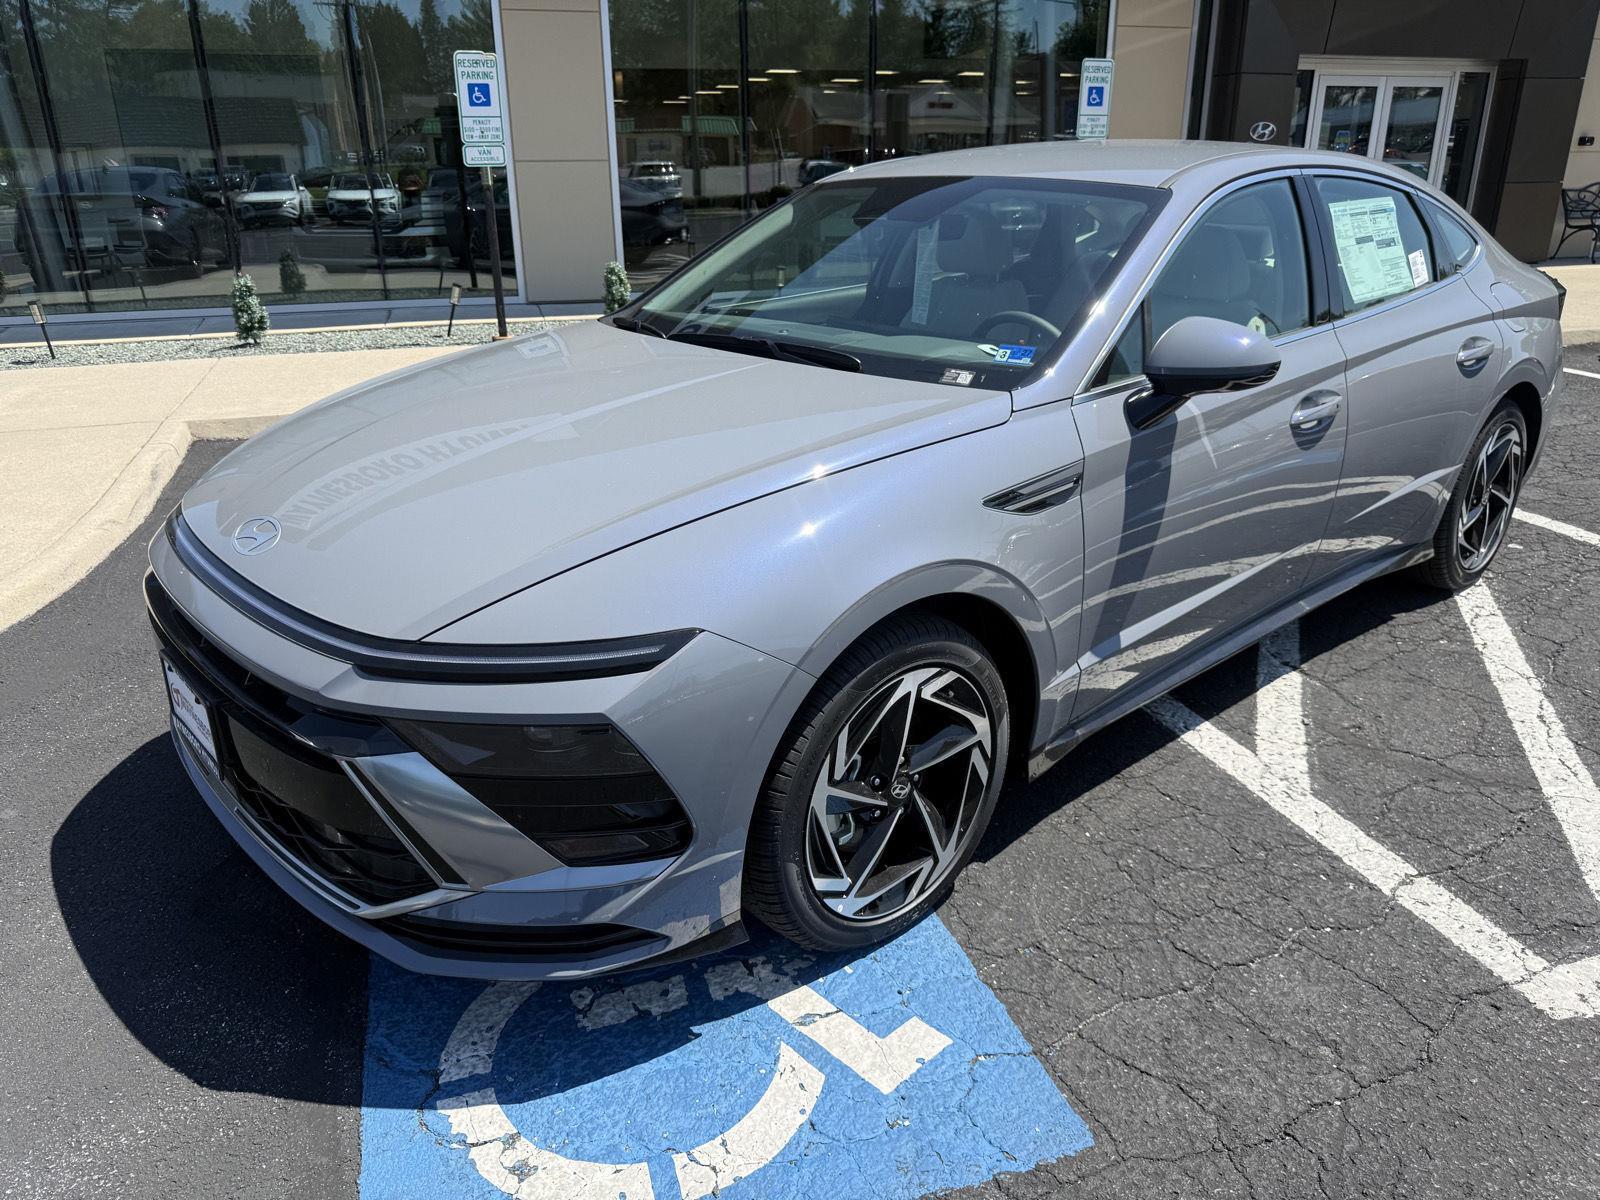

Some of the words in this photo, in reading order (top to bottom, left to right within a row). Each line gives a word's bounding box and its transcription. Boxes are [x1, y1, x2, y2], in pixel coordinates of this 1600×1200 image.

[458, 59, 496, 68] RESERVED
[1084, 66, 1111, 74] RESERVED
[461, 71, 494, 80] PARKING
[1085, 76, 1109, 84] PARKING
[1000, 350, 1008, 359] 3
